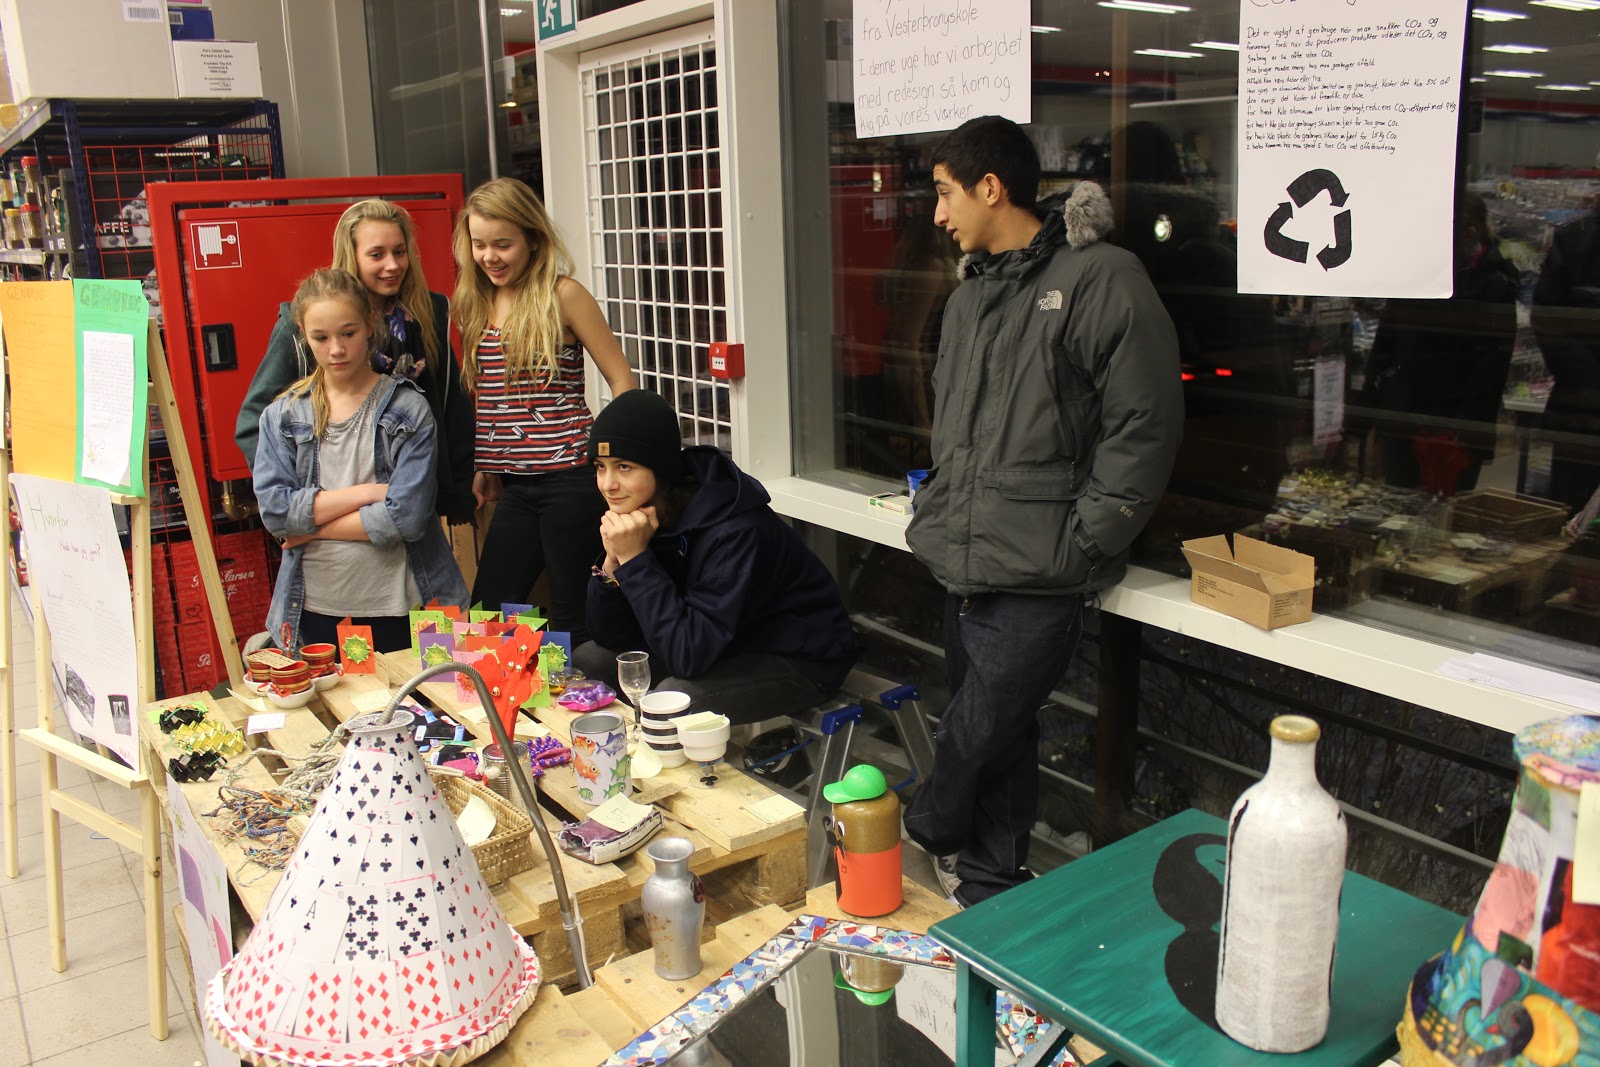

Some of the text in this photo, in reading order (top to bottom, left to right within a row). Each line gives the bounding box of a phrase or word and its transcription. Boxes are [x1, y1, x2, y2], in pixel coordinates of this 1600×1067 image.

[863, 18, 882, 40] fra
[1247, 26, 1260, 38] Det
[1296, 24, 1304, 35] at
[1428, 18, 1439, 28] og
[1405, 29, 1416, 37] det
[1437, 31, 1448, 39] og
[859, 27, 1023, 82] I denne uge har vi arbejdet
[858, 72, 1012, 111] med redesign så kom og
[1400, 77, 1411, 87] det
[859, 115, 875, 137] kig
[877, 108, 890, 134] på
[896, 108, 931, 128] vores
[94, 221, 129, 234] AFFE
[305, 899, 318, 920] A
